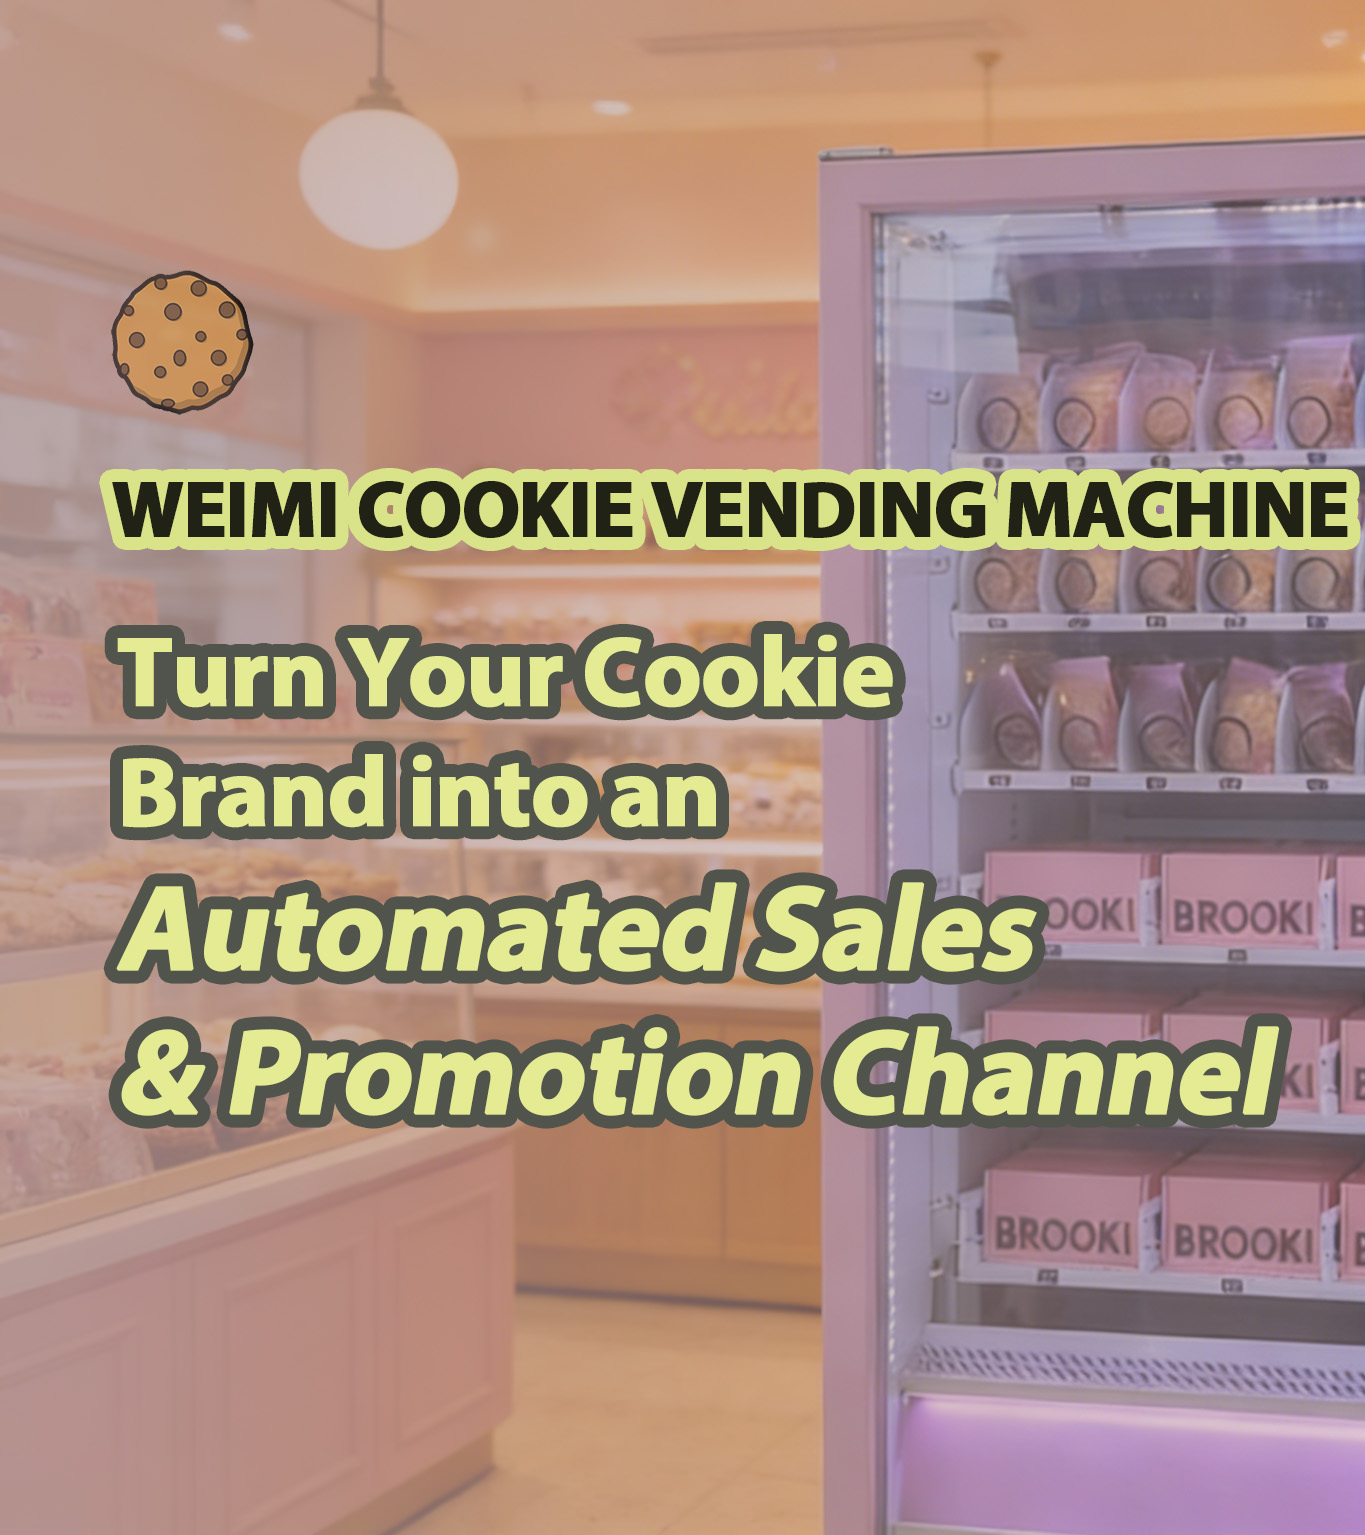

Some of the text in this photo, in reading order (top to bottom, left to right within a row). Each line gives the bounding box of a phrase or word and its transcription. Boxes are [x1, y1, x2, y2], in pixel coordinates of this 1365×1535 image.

[1044, 896, 1136, 933] OOKI
[1174, 898, 1314, 935] BROOKI
[995, 1215, 1132, 1255] BROOKI
[1173, 1223, 1314, 1264] BROOKI
